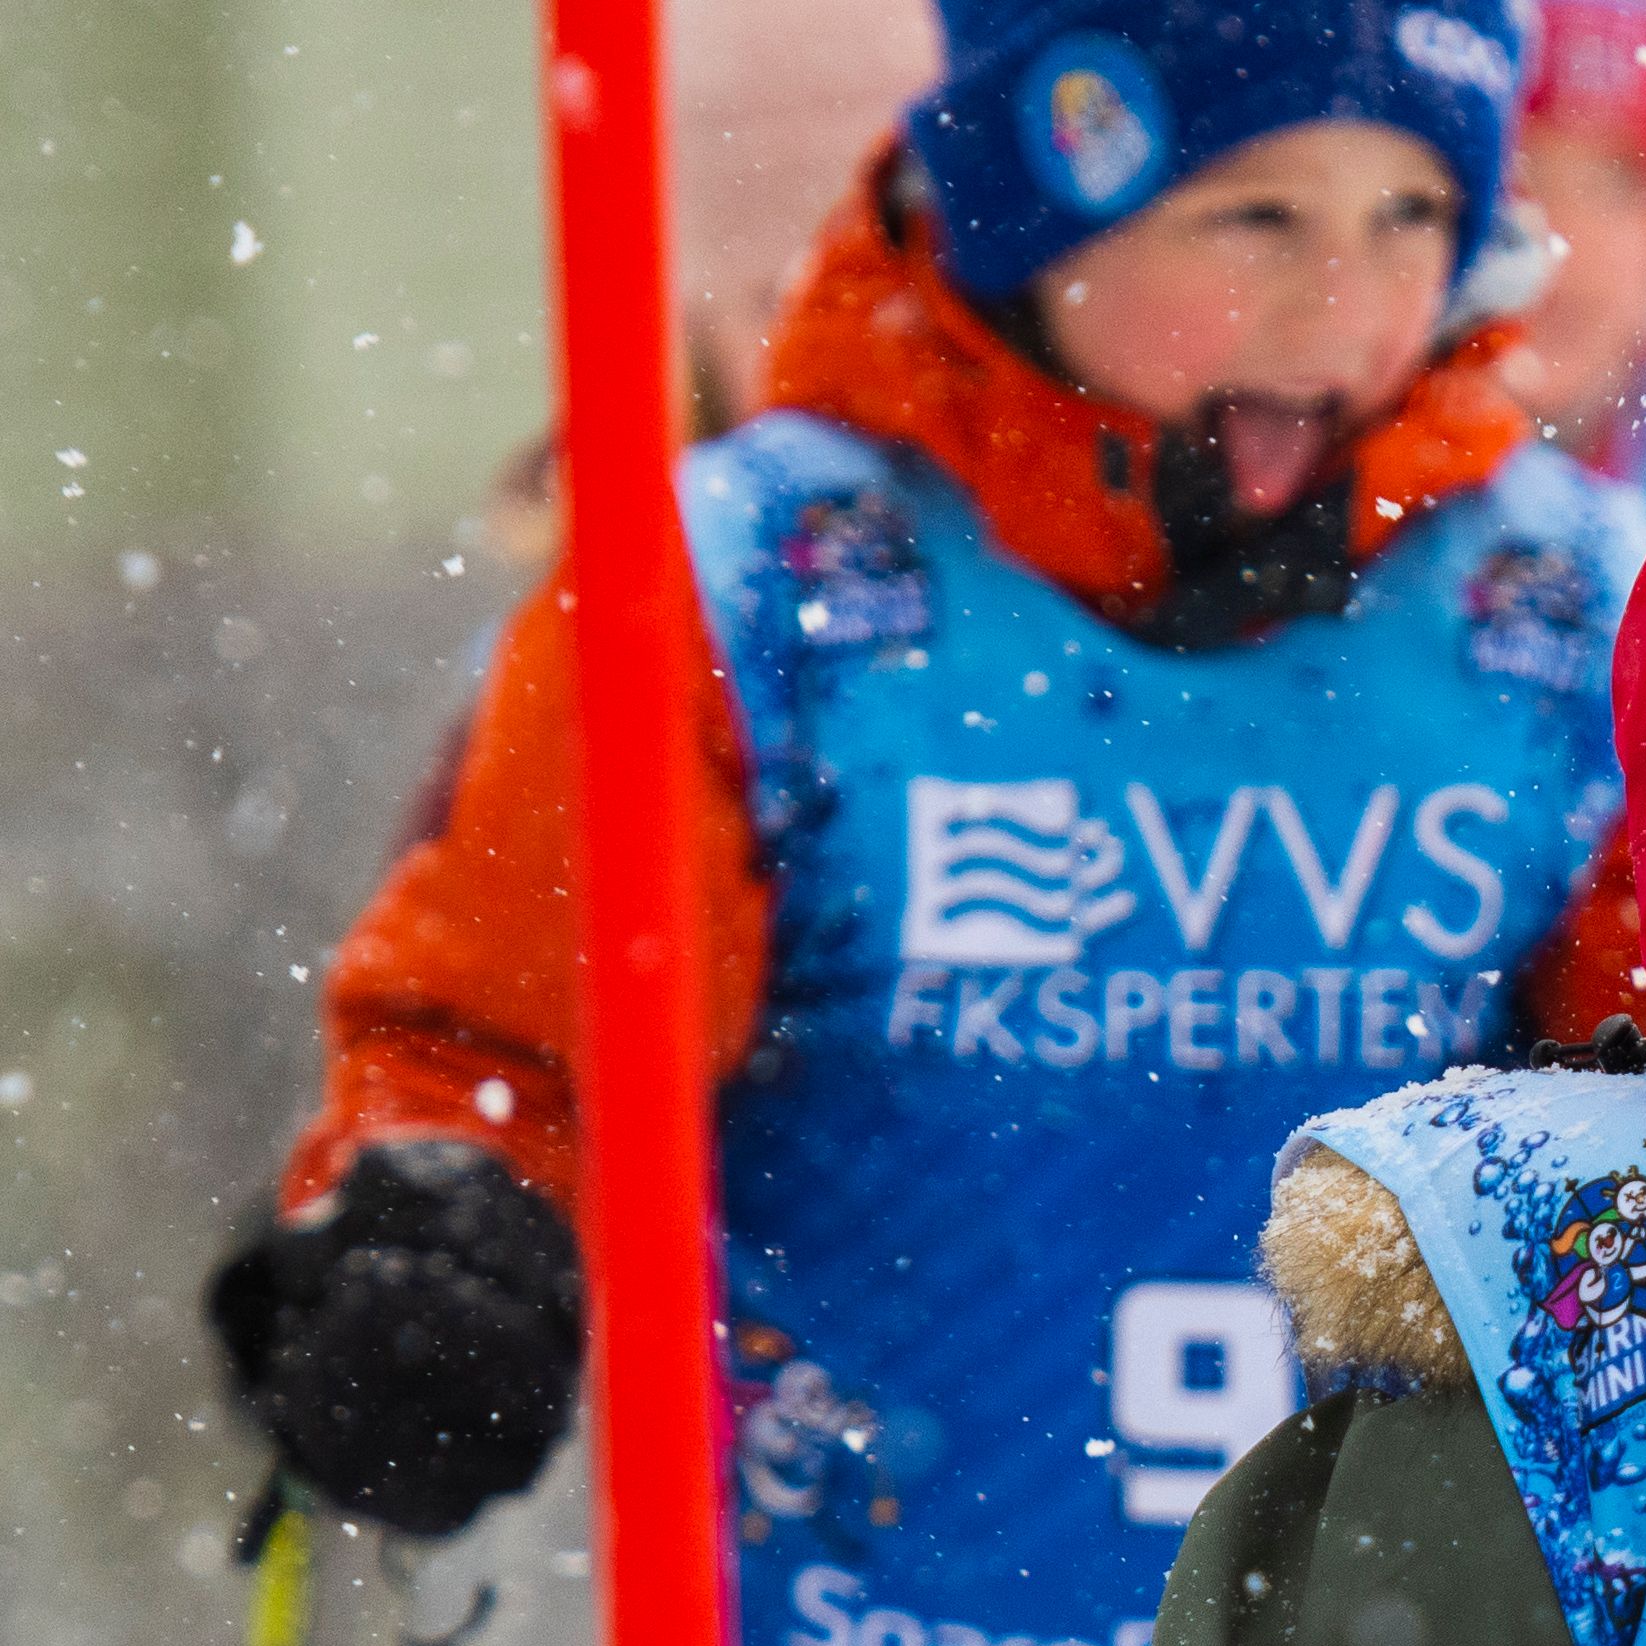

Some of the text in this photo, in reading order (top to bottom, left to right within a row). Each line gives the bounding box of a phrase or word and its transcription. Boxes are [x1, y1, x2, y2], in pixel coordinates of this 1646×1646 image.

[1126, 781, 1510, 960] VVS
[1110, 1278, 1300, 1525] 9
[1578, 1349, 1646, 1412] MINI
